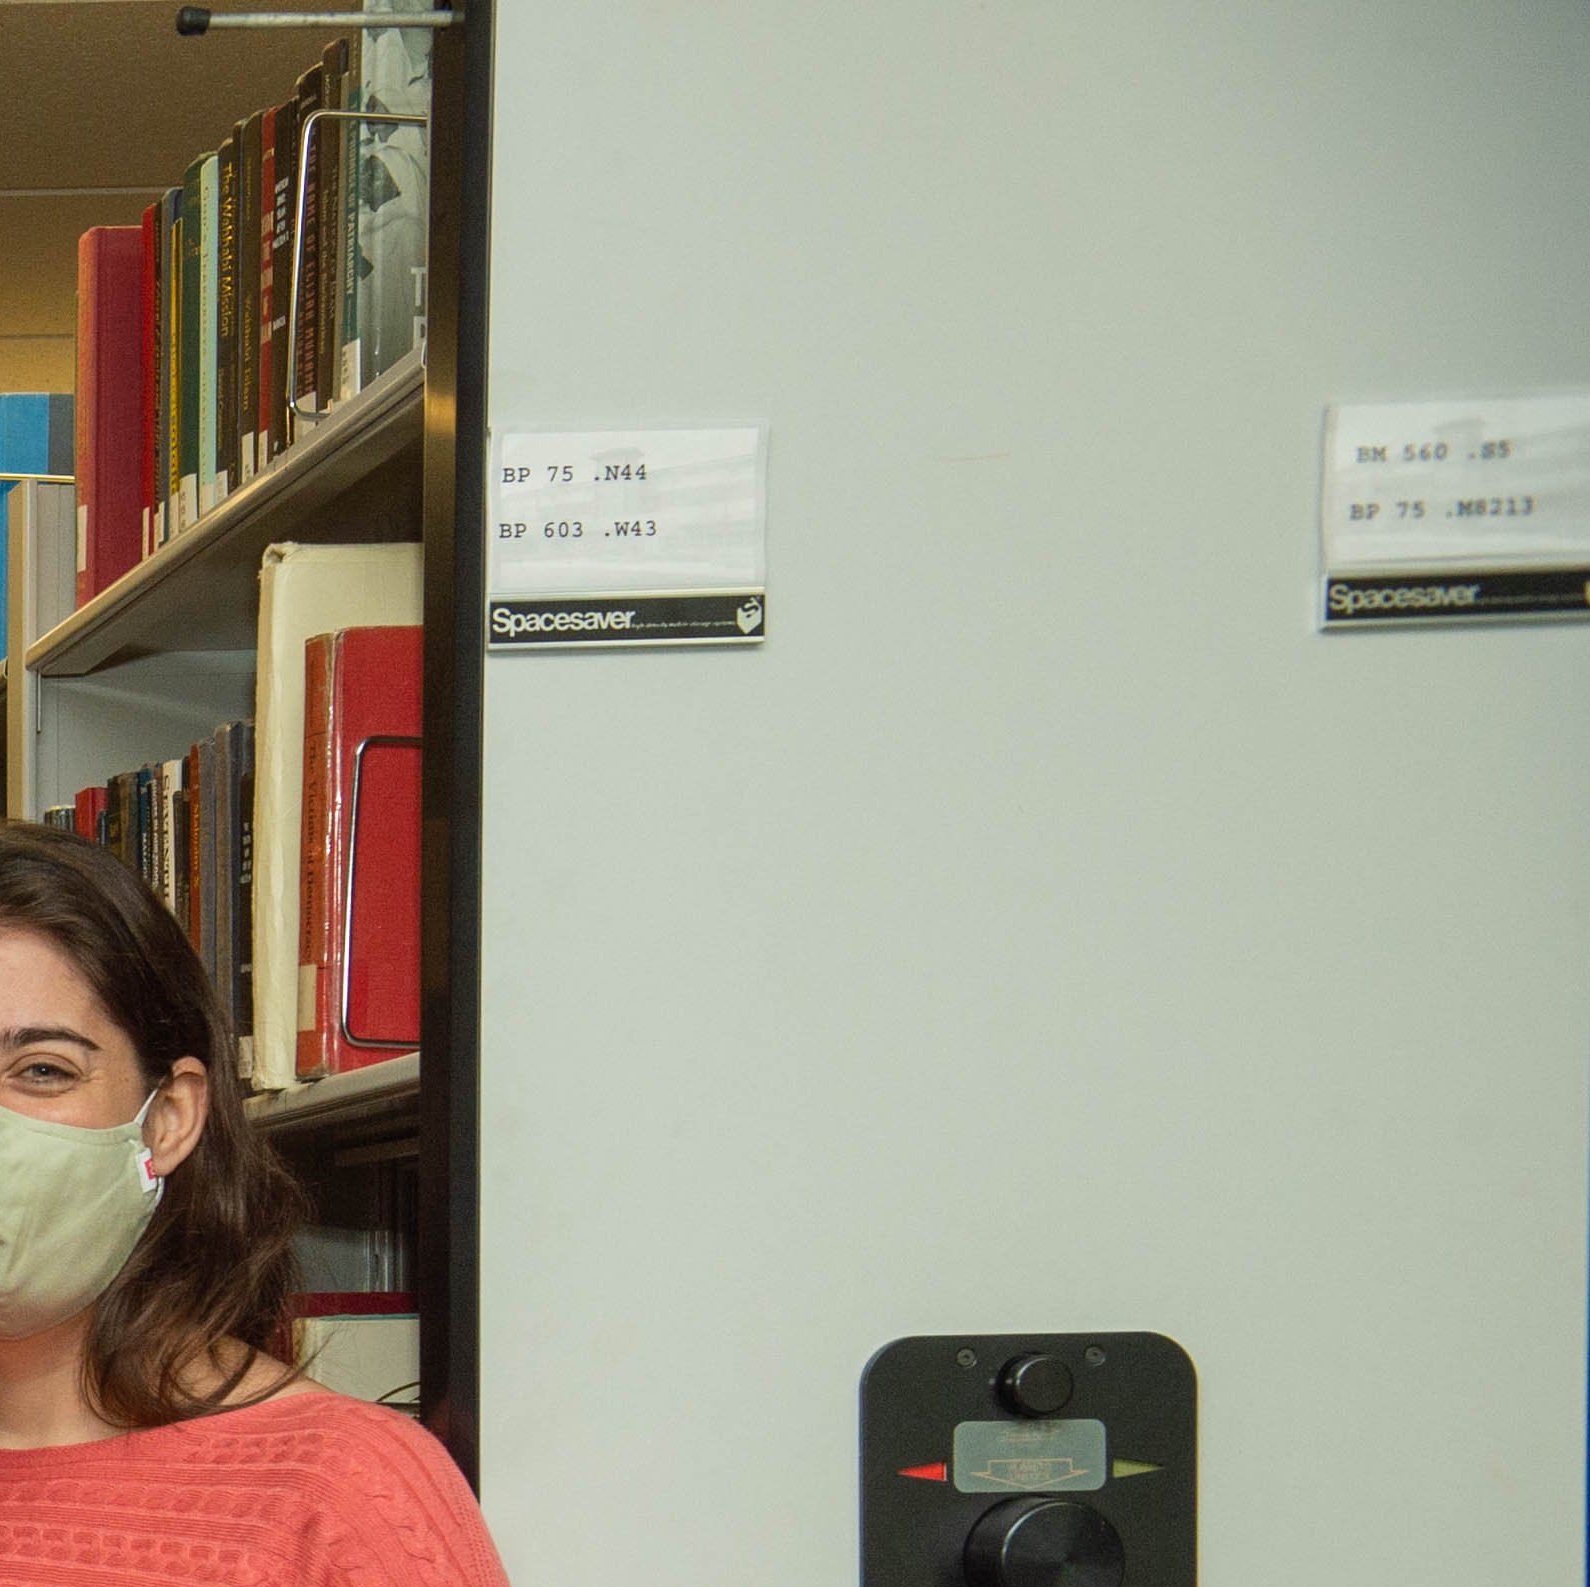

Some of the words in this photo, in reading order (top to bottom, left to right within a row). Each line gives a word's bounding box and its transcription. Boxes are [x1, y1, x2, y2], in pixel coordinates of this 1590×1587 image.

[222, 161, 233, 195] The
[221, 197, 234, 273] Wahhabi
[221, 275, 234, 337] Mission
[502, 467, 532, 484] BP
[547, 465, 574, 483] 75
[594, 464, 648, 482] .N44
[499, 523, 528, 539] BP
[543, 522, 584, 539] 603
[604, 520, 658, 538] .W43
[1329, 584, 1481, 616] Spacesaver
[492, 607, 636, 638] Spacesaver
